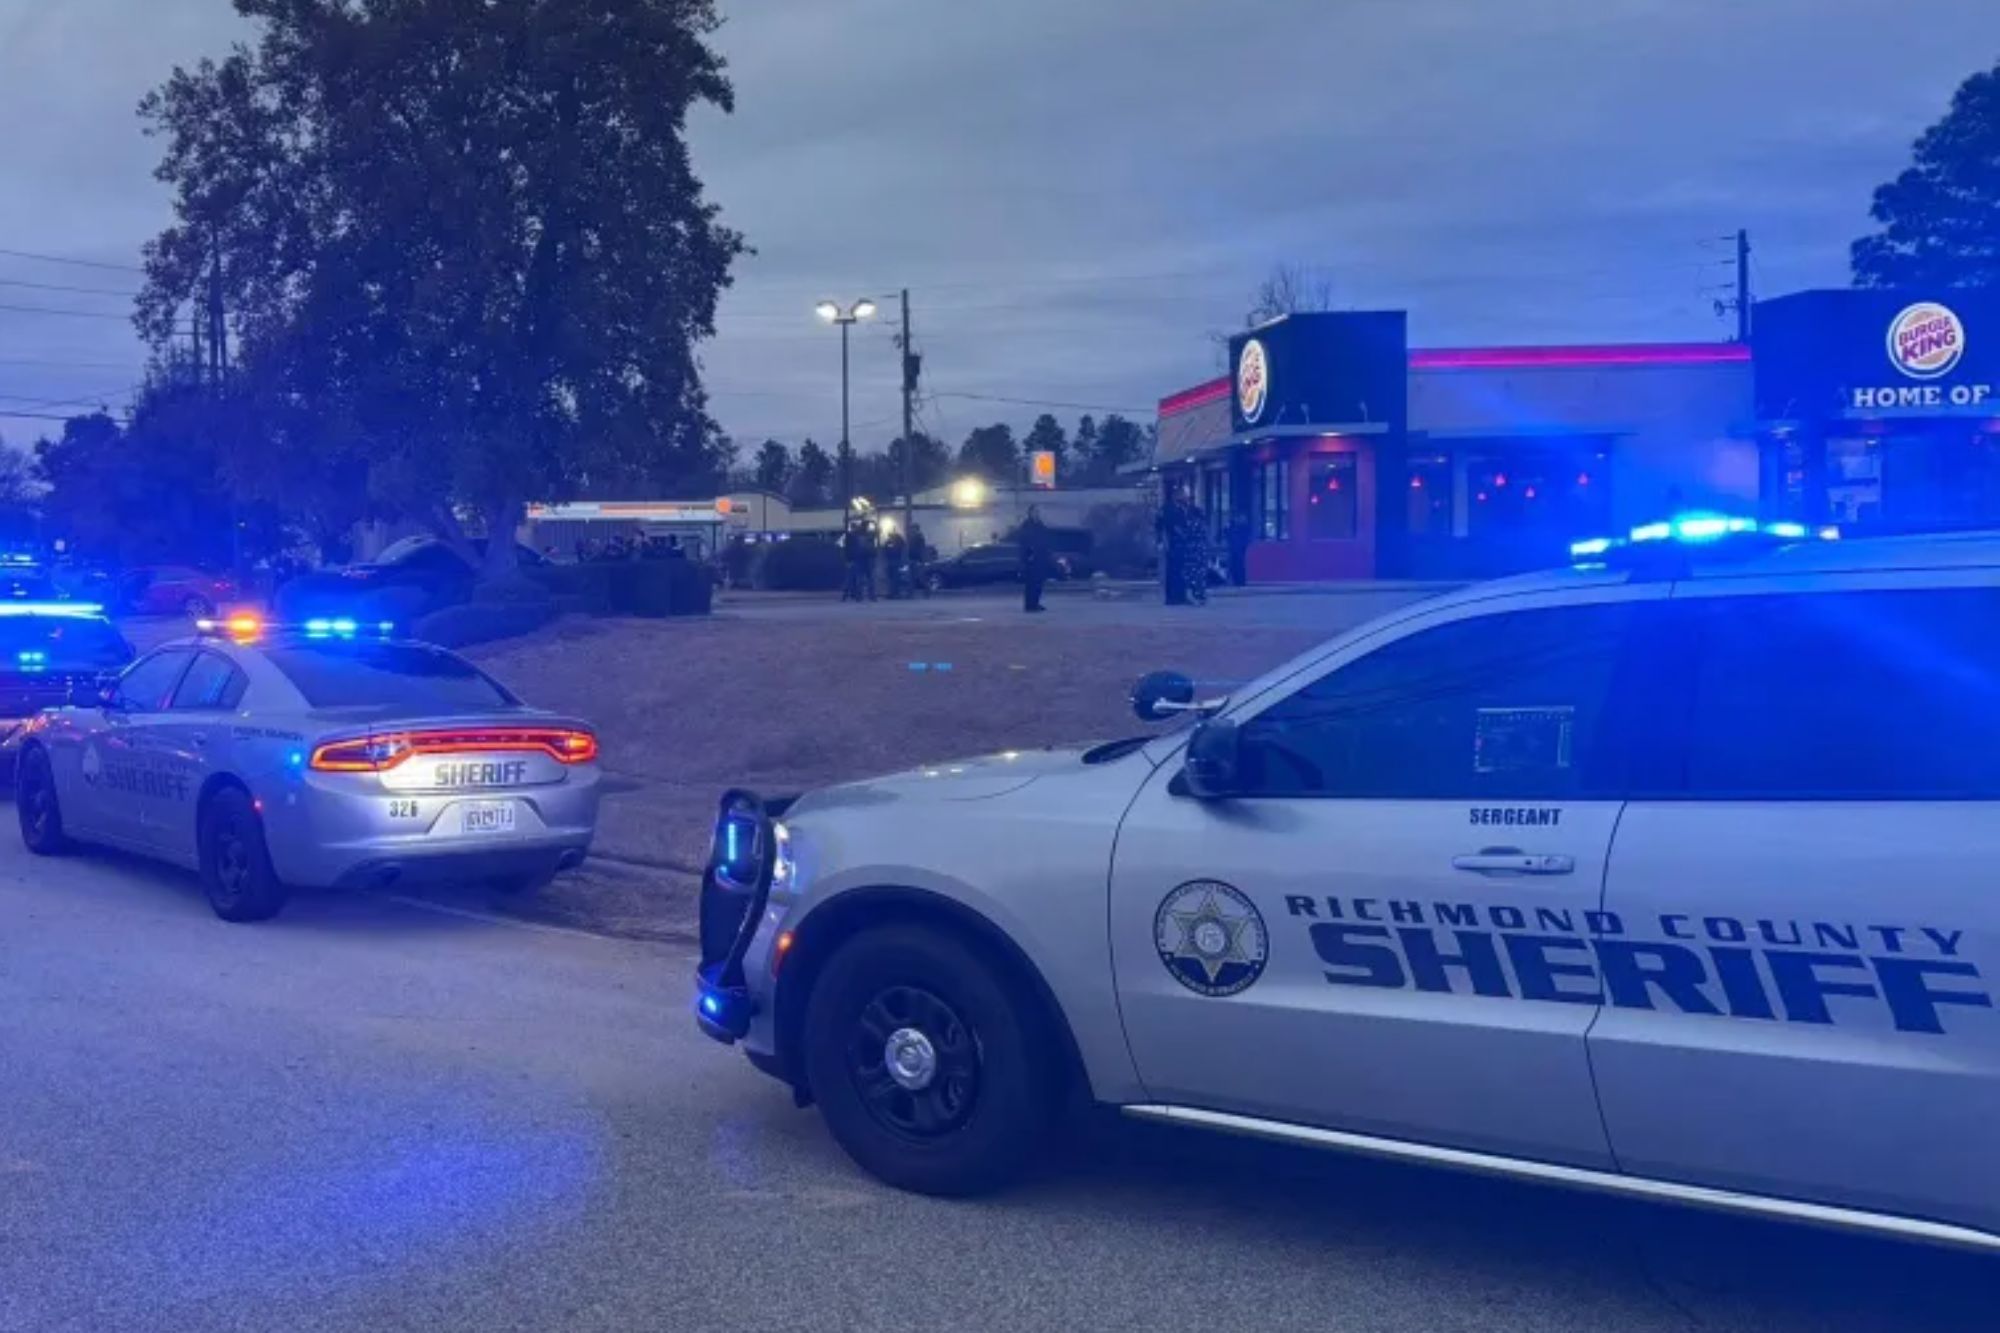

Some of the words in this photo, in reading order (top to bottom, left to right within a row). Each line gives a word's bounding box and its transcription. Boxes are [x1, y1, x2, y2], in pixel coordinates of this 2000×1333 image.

[1899, 316, 1953, 346] BURGER
[1902, 329, 1956, 362] KING
[1853, 386, 1941, 407] HOME
[1950, 385, 1990, 405] OF
[434, 761, 526, 786] SHERIFF
[1469, 807, 1562, 826] SERGEANT
[1285, 895, 1624, 934] RICHMOND
[1659, 914, 1963, 955] COUNTY
[1309, 922, 1992, 1034] SHERIFF
